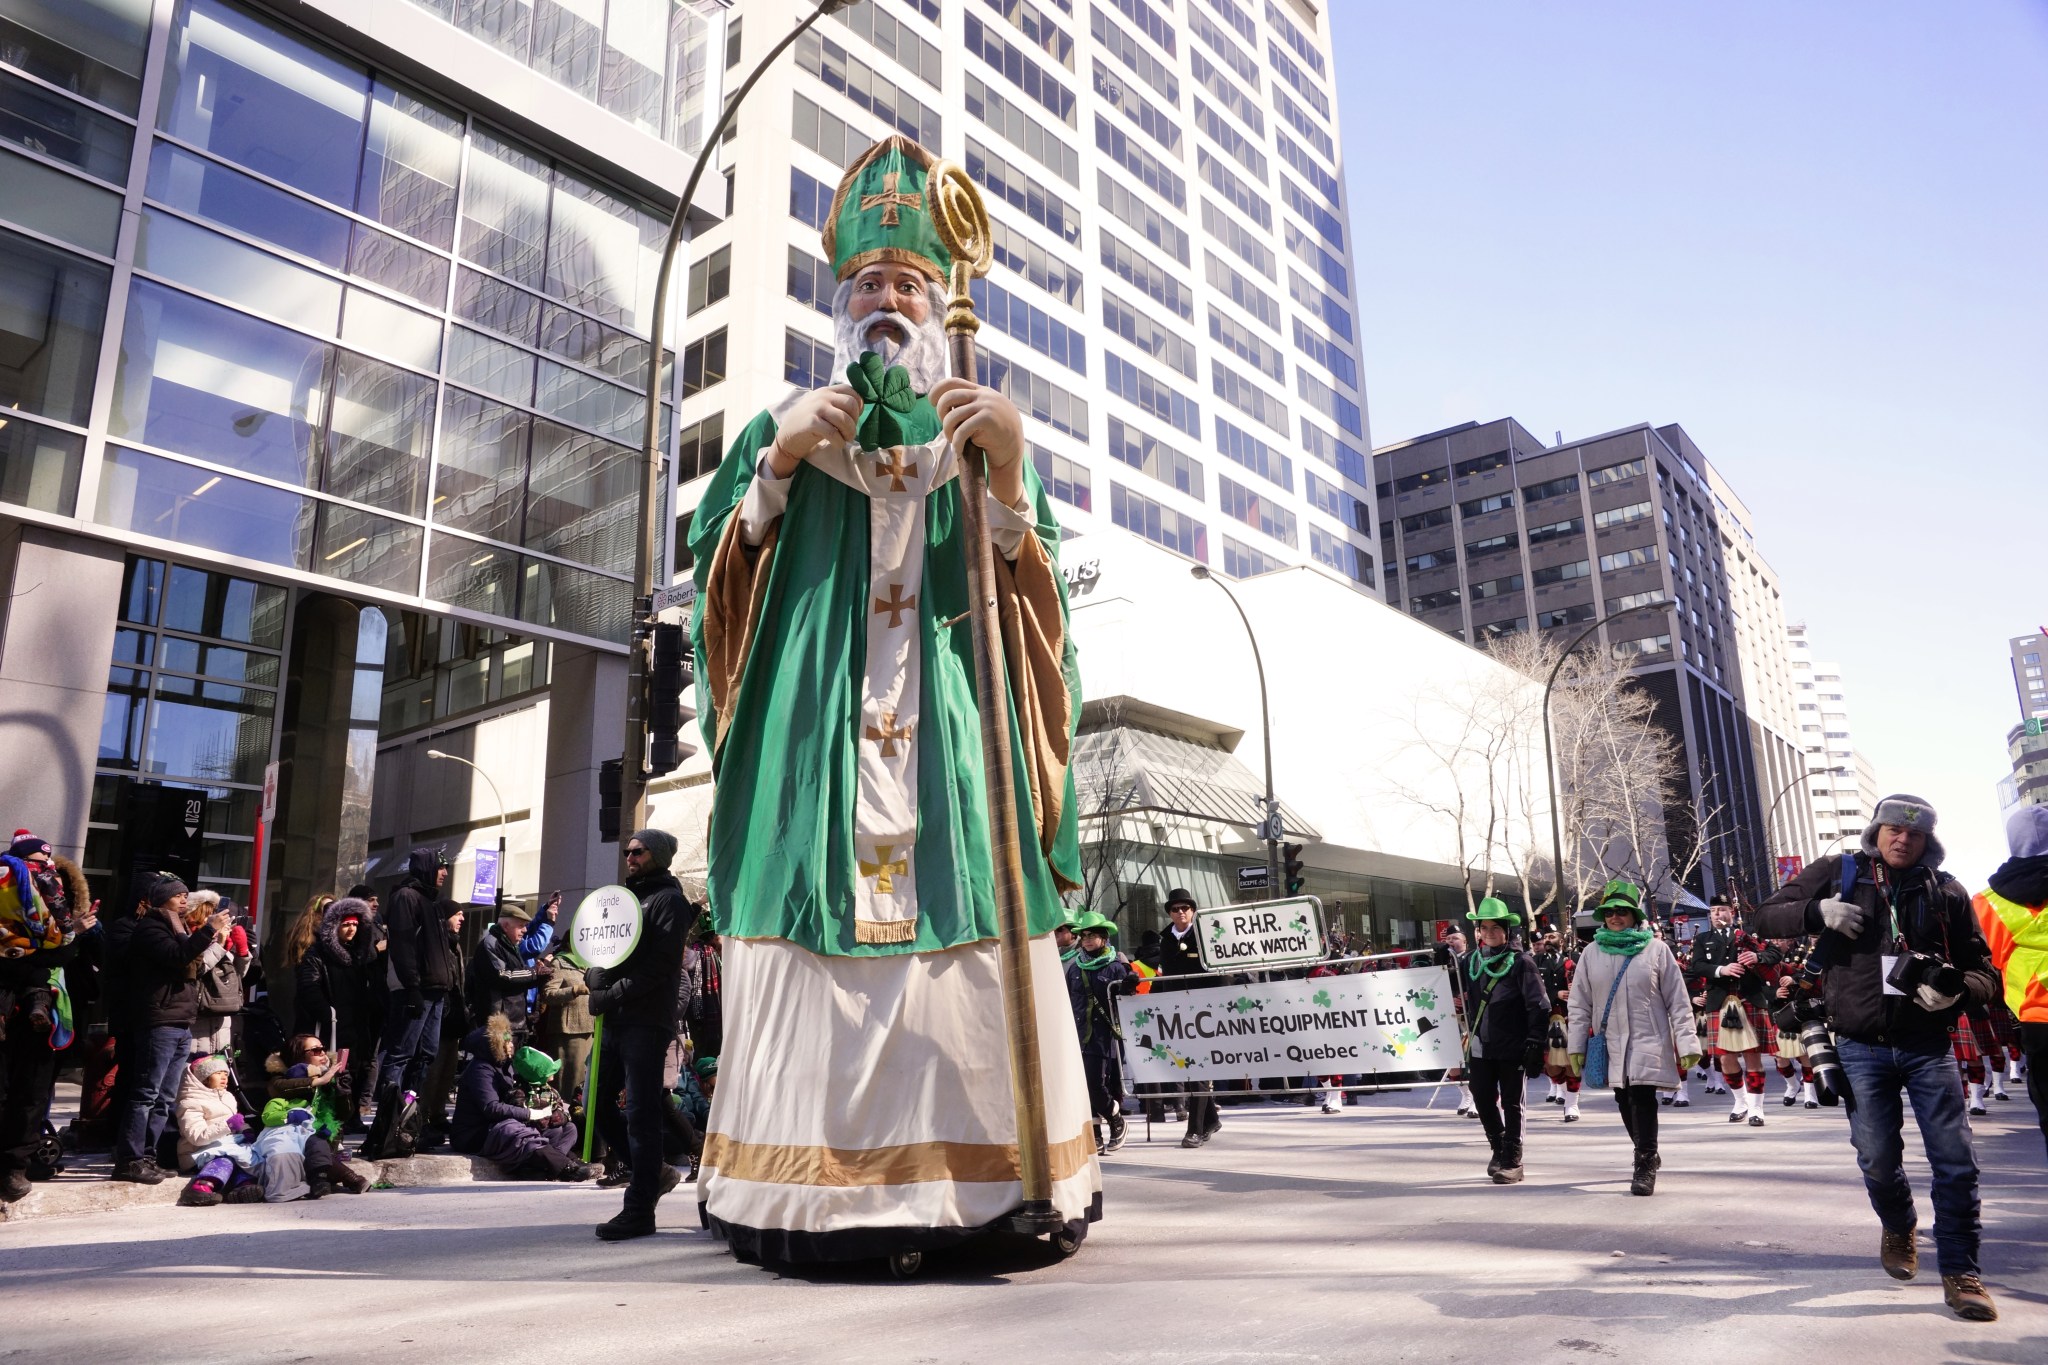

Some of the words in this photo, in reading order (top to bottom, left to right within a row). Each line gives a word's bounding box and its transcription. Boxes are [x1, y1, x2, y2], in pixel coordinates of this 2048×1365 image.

[667, 588, 698, 604] Robert-
[186, 800, 201, 814] 20
[596, 894, 620, 907] Irlande
[579, 922, 632, 941] ST-PATRICK
[1233, 913, 1282, 935] R.H.R.
[592, 943, 616, 956] Ireland
[1214, 940, 1258, 959] BLACK
[1260, 935, 1307, 954] WATCH
[1157, 1010, 1256, 1040] McCANN
[1259, 1009, 1368, 1035] EQUIPMENT
[1374, 1006, 1411, 1026] Ltd.
[1210, 1047, 1269, 1065] Dorval
[1286, 1043, 1358, 1062] Quebec
